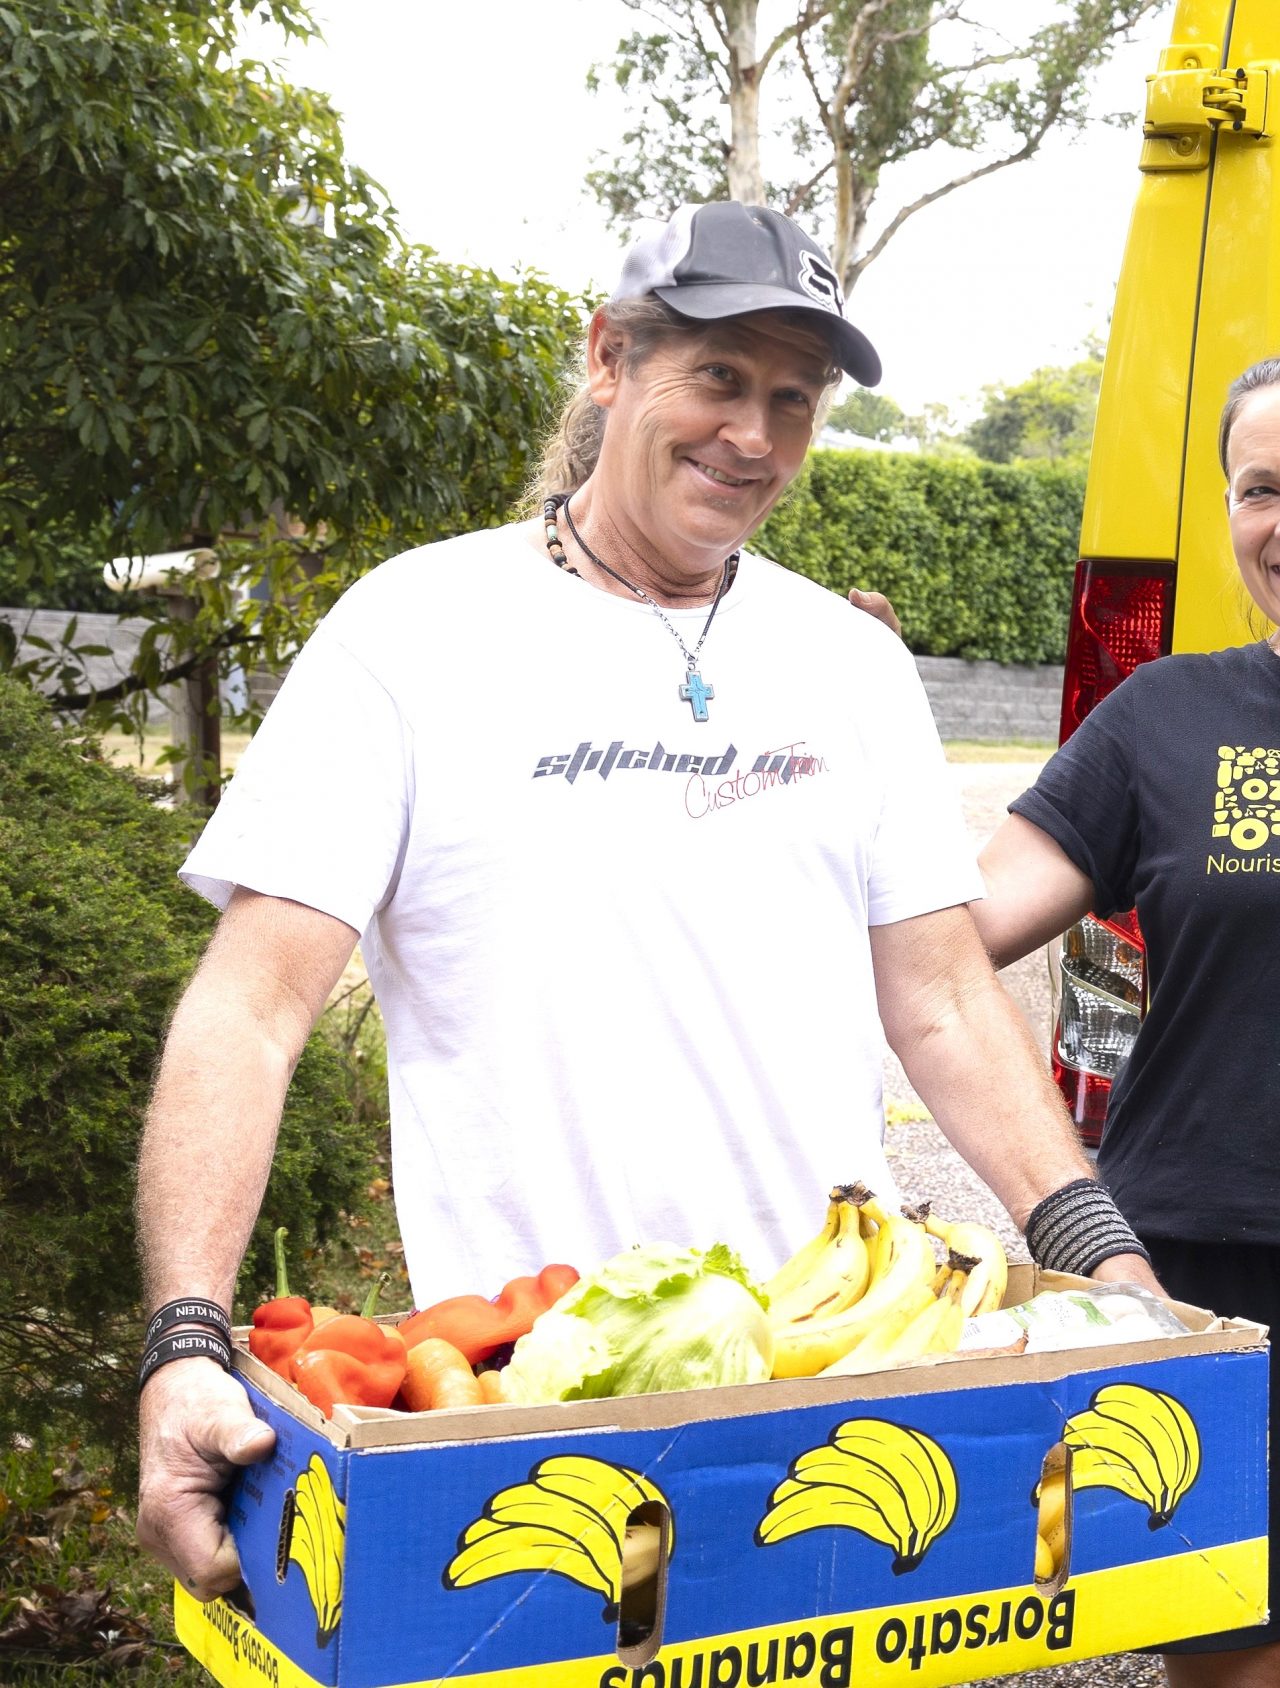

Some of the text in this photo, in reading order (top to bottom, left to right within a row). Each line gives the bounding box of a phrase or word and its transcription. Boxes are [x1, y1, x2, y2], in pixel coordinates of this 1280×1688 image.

[531, 741, 738, 785] stitched
[175, 1305, 207, 1317] KLEIN
[172, 1337, 207, 1351] KLEIN
[875, 1588, 1076, 1672] Borsato
[241, 1629, 279, 1688] Borsato
